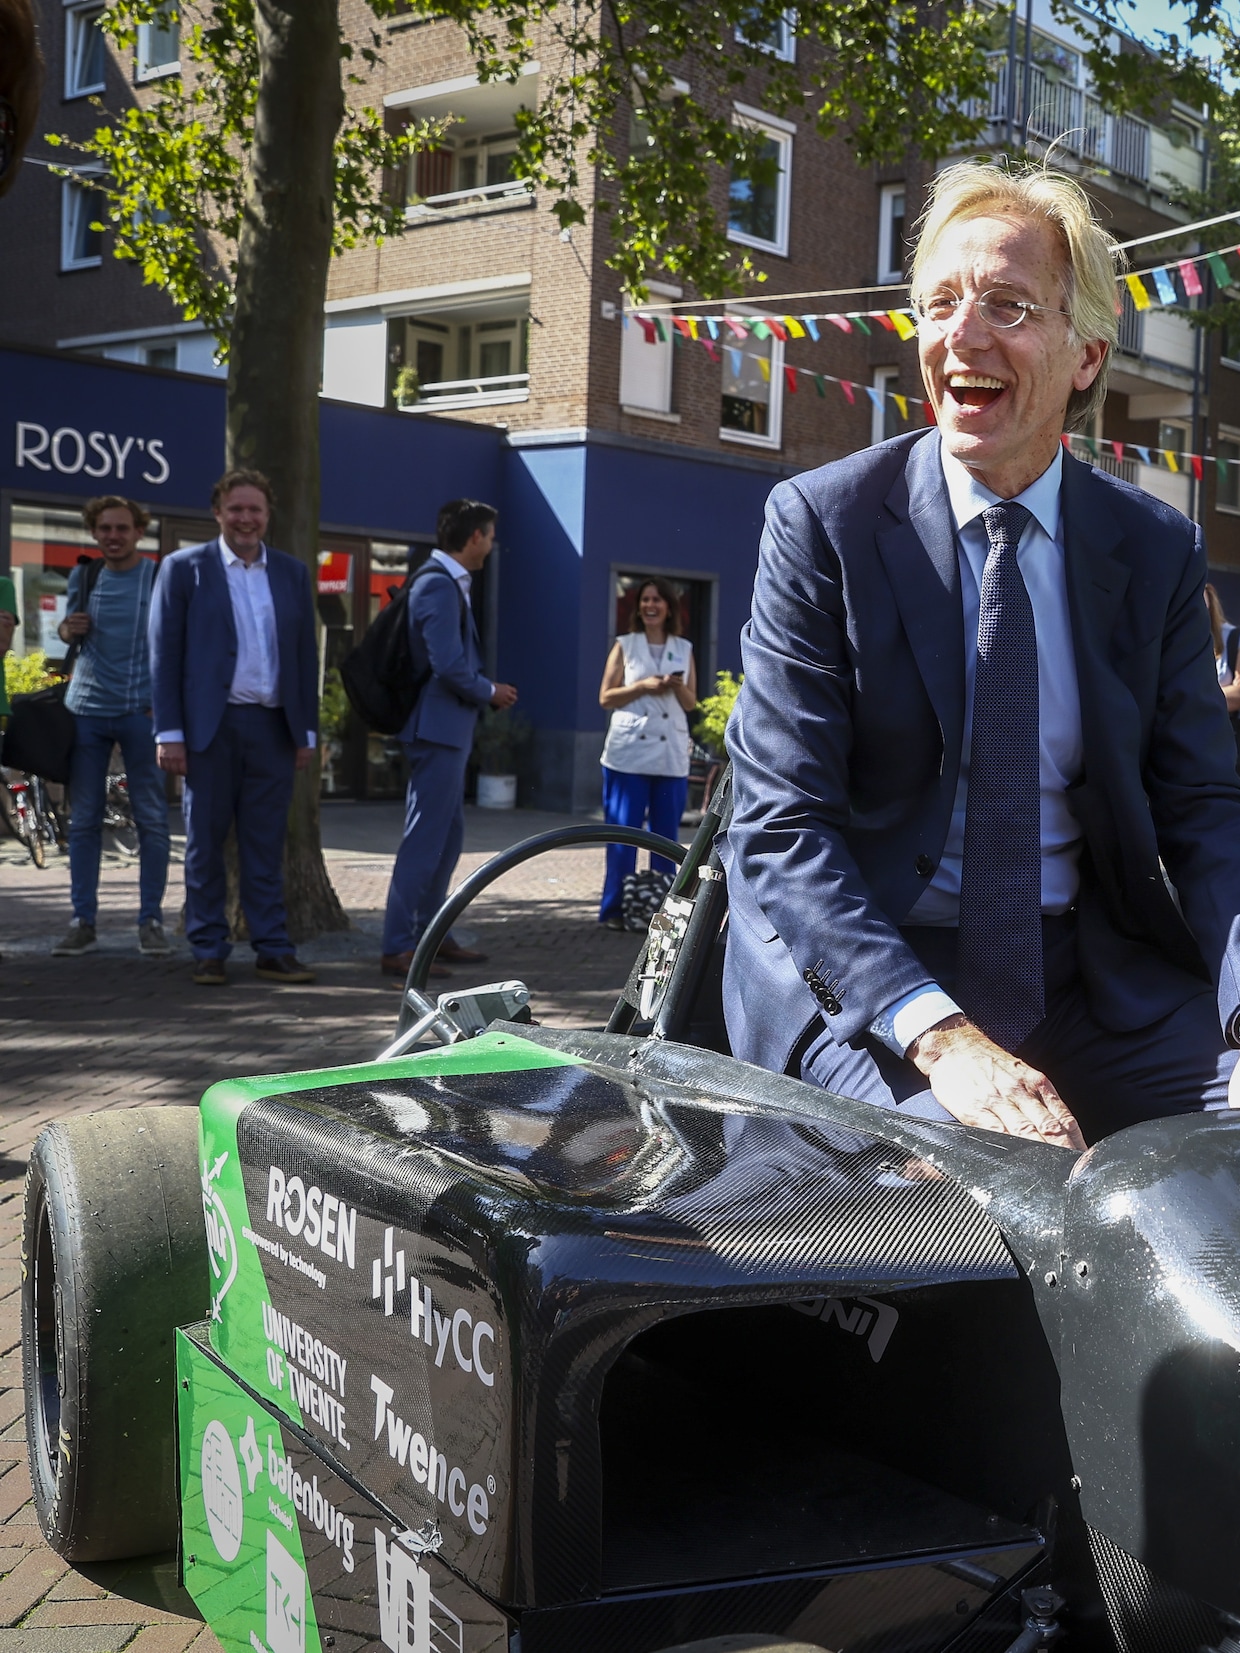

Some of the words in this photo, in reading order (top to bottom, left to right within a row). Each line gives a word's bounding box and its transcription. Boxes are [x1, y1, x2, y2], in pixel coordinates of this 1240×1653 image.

[16, 420, 171, 485] ROSY'S
[266, 1165, 357, 1270] ROSEN
[280, 1244, 289, 1266] by
[289, 1251, 327, 1290] technology
[261, 1300, 347, 1398] UNIVERSITY
[410, 1276, 495, 1388] HyCC
[266, 1347, 285, 1391] OF
[286, 1361, 351, 1451] TWENTE.
[267, 1435, 355, 1573] batenburg
